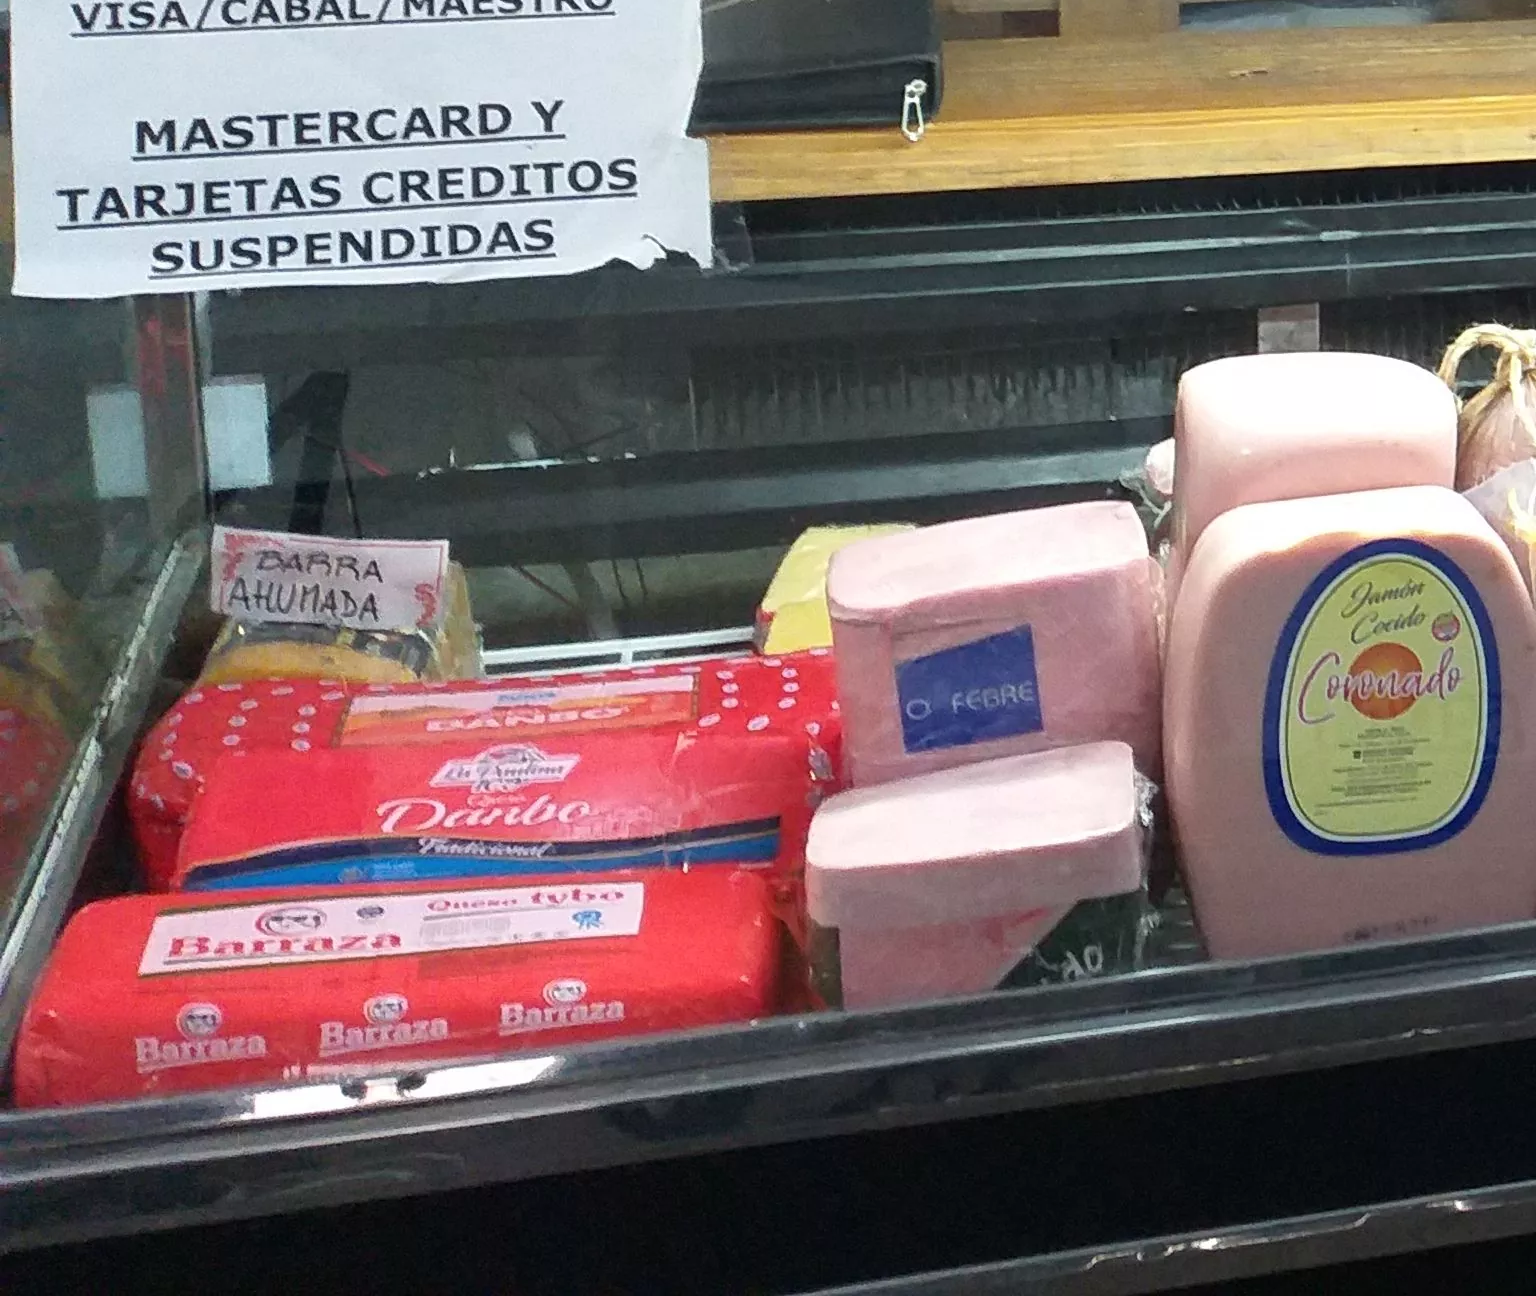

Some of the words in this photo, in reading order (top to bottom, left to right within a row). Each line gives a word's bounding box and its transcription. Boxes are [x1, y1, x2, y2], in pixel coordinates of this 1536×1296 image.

[133, 104, 512, 155] MASTERCARD
[530, 100, 564, 133] Y
[57, 174, 342, 224] TARJETAS
[362, 158, 638, 206] CREDITOS
[149, 220, 556, 274] SUSPENDIDAS
[255, 549, 384, 584] BARRA
[229, 575, 381, 623] AHUMADA
[1340, 580, 1428, 619] Jamón
[1350, 604, 1428, 645] Cocido
[1298, 642, 1465, 727] Coronado
[376, 793, 592, 833] Danbo
[165, 930, 403, 961] Barraza
[319, 1015, 449, 1053] Barraza
[500, 999, 626, 1034] Barraza
[134, 1033, 267, 1066] Barraza
